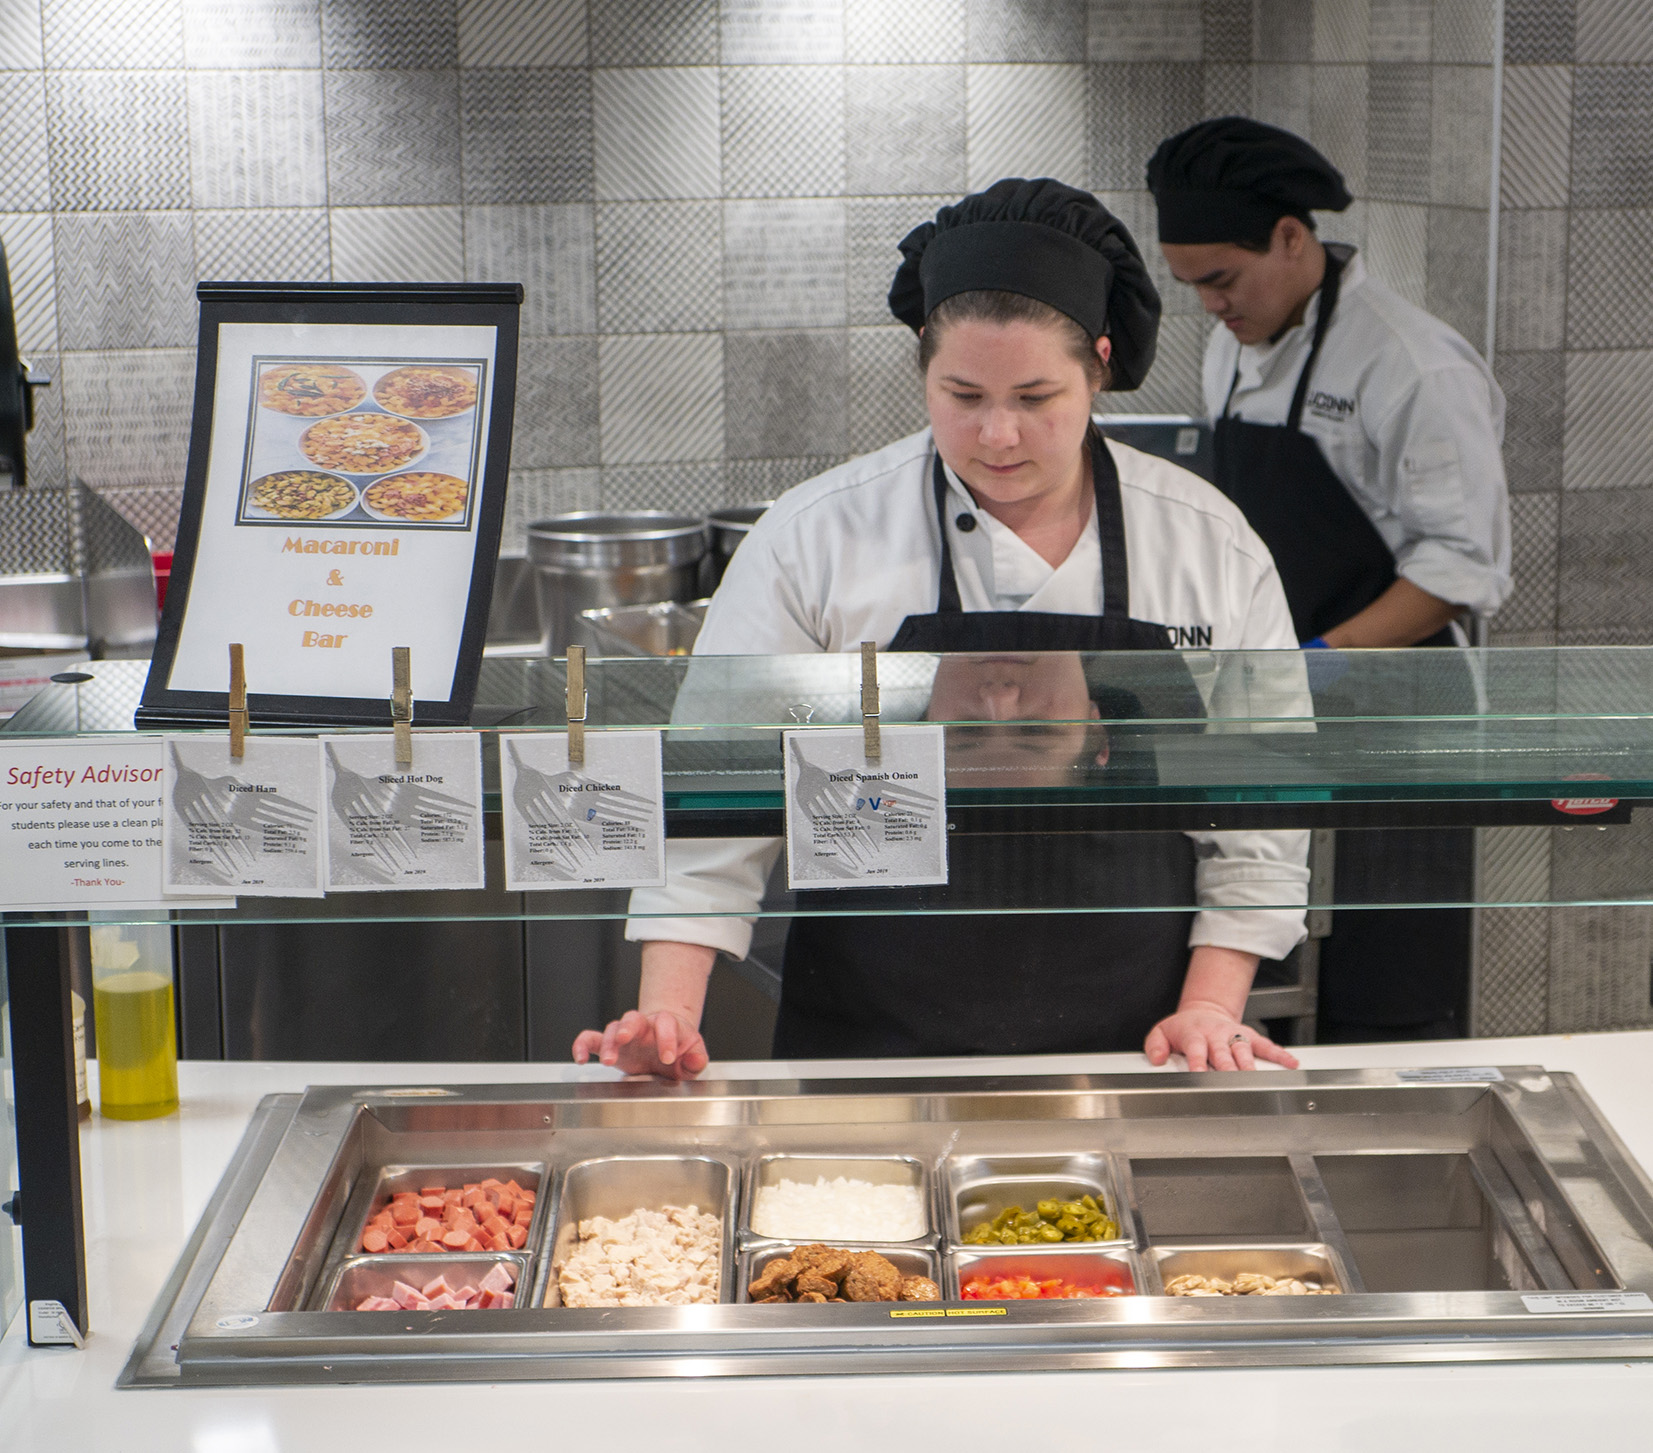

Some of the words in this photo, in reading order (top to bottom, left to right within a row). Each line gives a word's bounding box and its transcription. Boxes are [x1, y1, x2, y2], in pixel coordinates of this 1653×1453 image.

[1308, 391, 1355, 412] CONN
[281, 536, 399, 556] Macaroni
[326, 568, 344, 586] &
[288, 599, 373, 618] Cheese
[301, 630, 348, 648] Bar
[6, 765, 75, 789] Safety
[81, 764, 163, 783] Advisor
[378, 775, 404, 784] Sliced
[407, 775, 423, 783] Hot
[425, 774, 443, 784] Dog
[829, 774, 853, 782] Diced
[856, 772, 889, 783] Spanish
[229, 783, 253, 793] Diced
[256, 785, 277, 793] Ham
[559, 784, 583, 792] Diced
[585, 783, 621, 792] Chicken
[15, 802, 38, 812] your
[41, 800, 71, 811] safety
[74, 799, 93, 809] and
[95, 799, 117, 808] that
[119, 798, 129, 807] of
[132, 800, 155, 809] your
[869, 797, 881, 810] V
[11, 820, 55, 830] students
[58, 819, 90, 830] please
[92, 820, 110, 828] use
[112, 820, 118, 828] a
[121, 818, 148, 828] clean
[28, 840, 52, 850] each
[54, 840, 78, 849] time
[80, 841, 99, 850] you
[102, 840, 129, 848] come
[132, 839, 143, 847] to
[145, 838, 162, 847] the
[64, 858, 100, 869] serving
[103, 858, 129, 867] lines.
[70, 878, 102, 887] -Thank
[104, 878, 125, 886] You-
